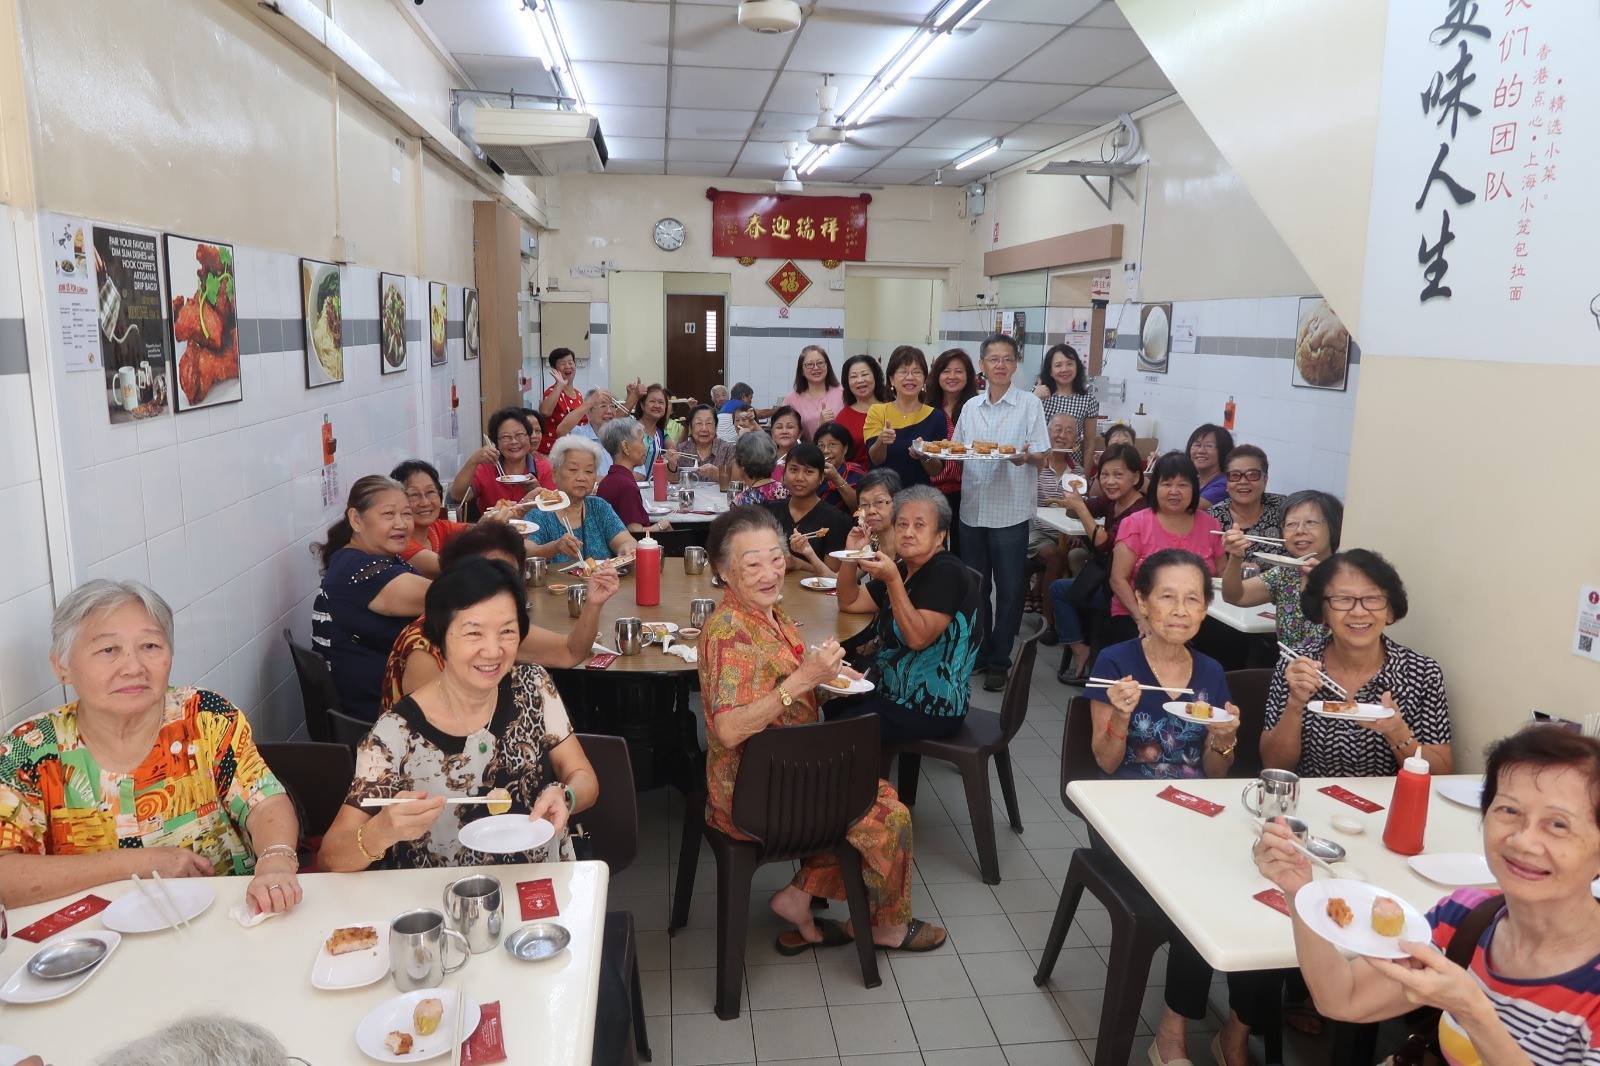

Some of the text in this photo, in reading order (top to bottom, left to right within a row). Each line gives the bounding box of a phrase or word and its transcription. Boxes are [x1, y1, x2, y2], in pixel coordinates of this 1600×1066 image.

[109, 236, 154, 251] PAIR YOUR FAVOURITE
[112, 248, 121, 257] DIM
[122, 249, 132, 258] SUM
[132, 251, 147, 260] DISHES
[123, 260, 156, 271] HOOK COFFEE'S
[134, 272, 156, 281] ARTISANAL
[780, 271, 800, 293] 福
[134, 282, 144, 290] DRIP
